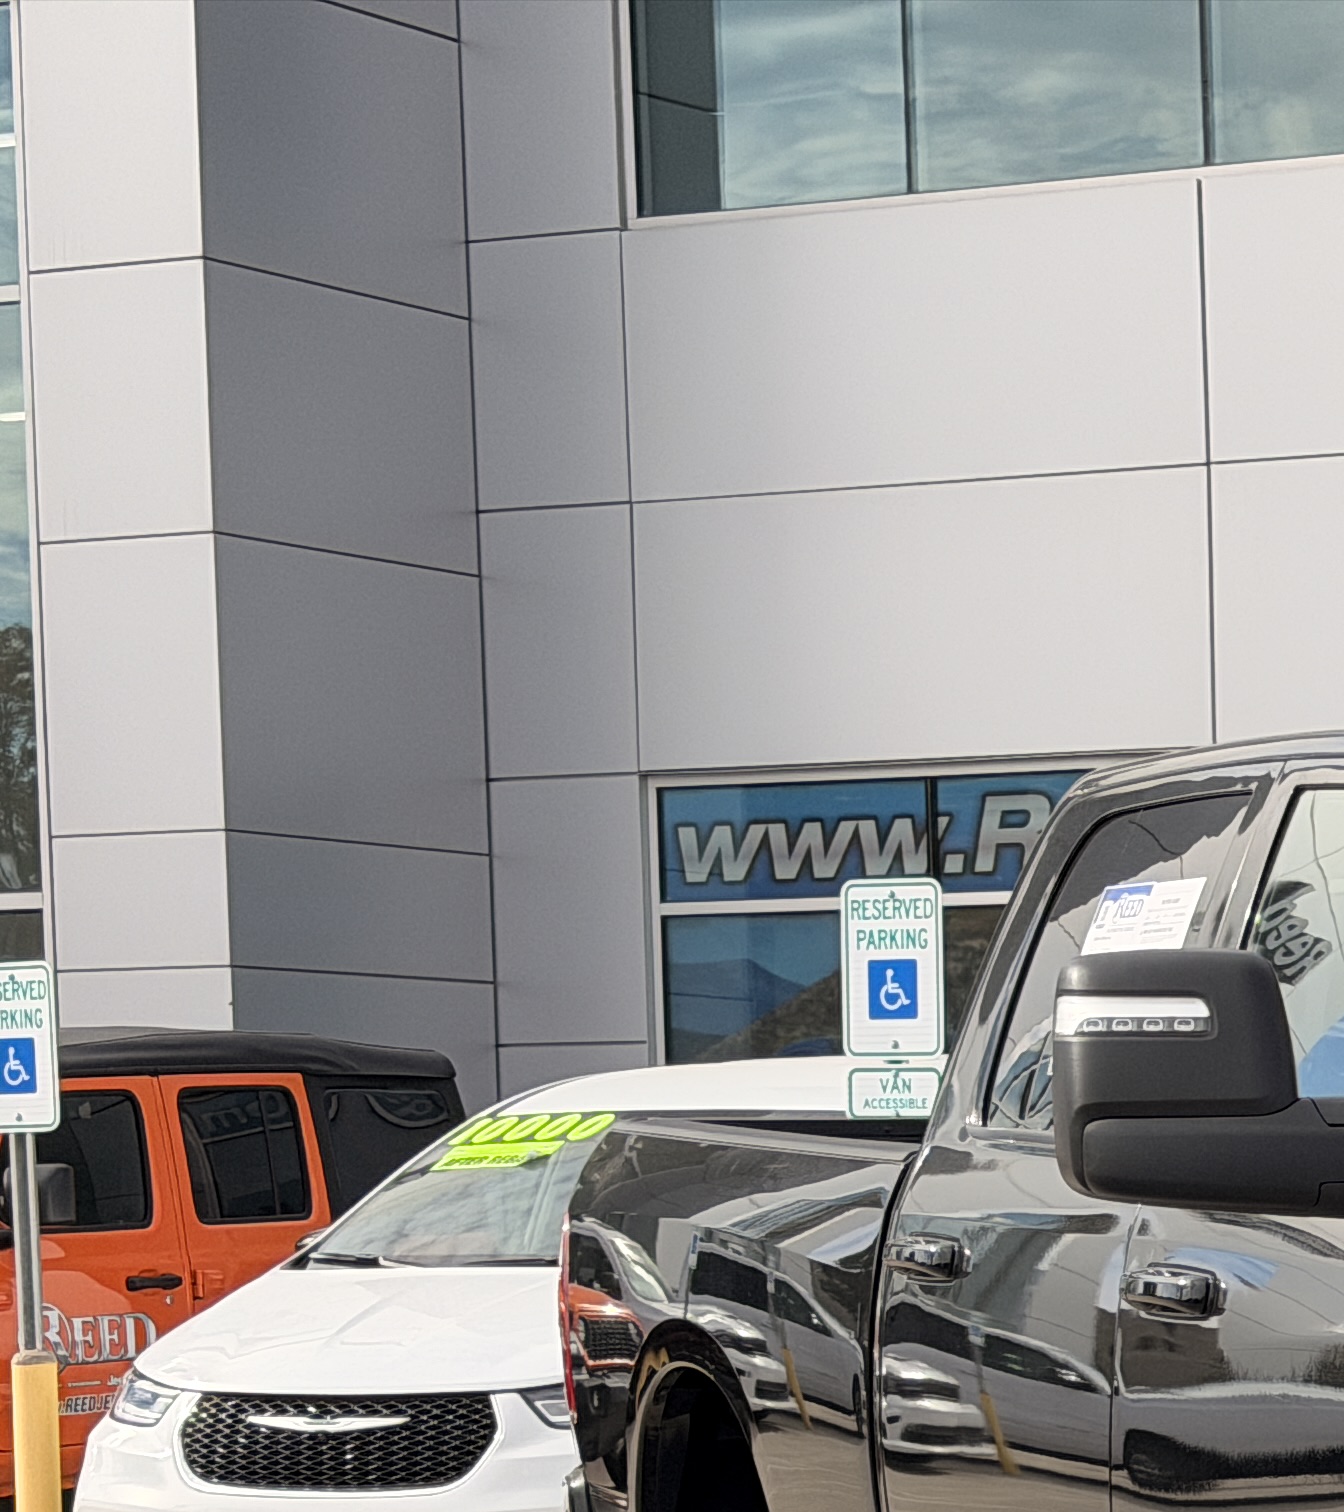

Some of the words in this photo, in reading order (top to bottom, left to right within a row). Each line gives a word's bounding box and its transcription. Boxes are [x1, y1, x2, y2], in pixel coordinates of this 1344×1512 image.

[851, 898, 934, 920] RESERVED
[856, 927, 929, 951] PARKING
[0, 1008, 44, 1029] RKING
[880, 1078, 912, 1094] VAN
[863, 1098, 928, 1110] ACCESSIBLE
